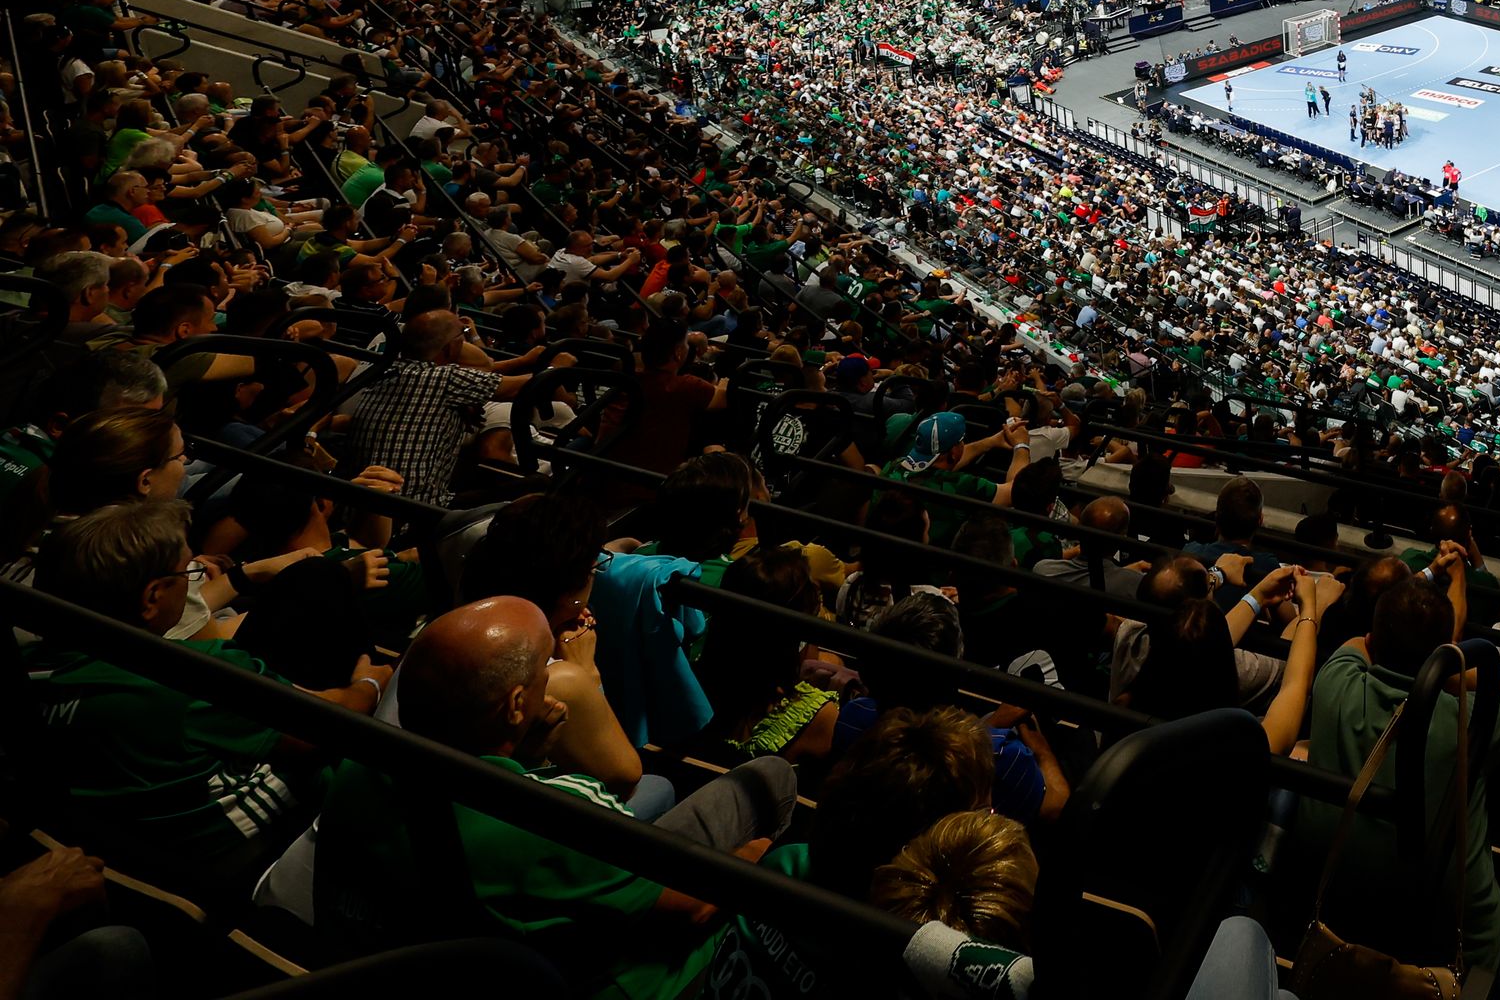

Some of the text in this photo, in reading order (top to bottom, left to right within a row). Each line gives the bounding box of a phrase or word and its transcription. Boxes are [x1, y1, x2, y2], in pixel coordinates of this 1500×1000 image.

[1197, 37, 1280, 70] SZABADICS
[1380, 46, 1415, 54] OMV
[1417, 90, 1479, 106] mateco
[784, 956, 816, 994] ETO
